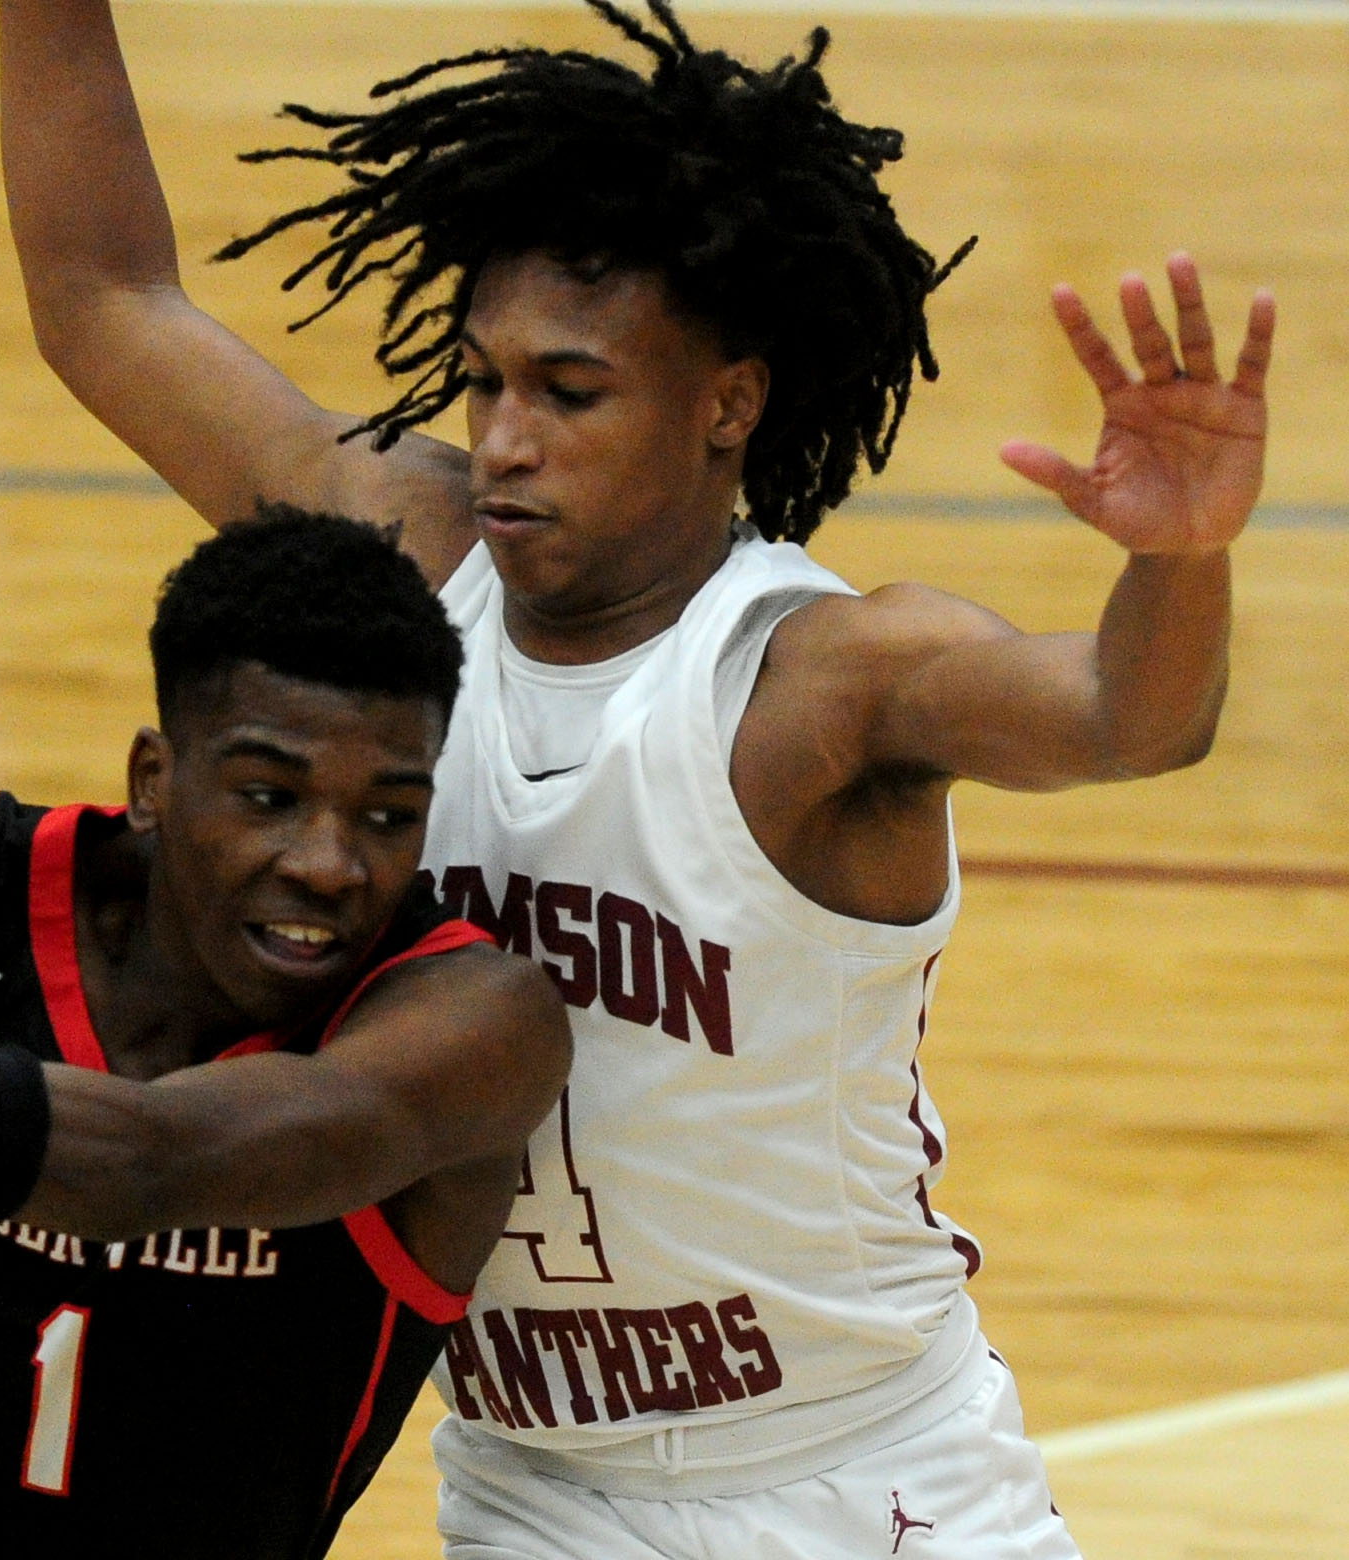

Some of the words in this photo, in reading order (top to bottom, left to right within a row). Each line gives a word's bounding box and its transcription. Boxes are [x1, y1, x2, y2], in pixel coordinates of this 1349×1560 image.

[416, 866, 735, 1056] MSON
[20, 1302, 91, 1497] 1
[446, 1294, 784, 1430] PANTHERS
